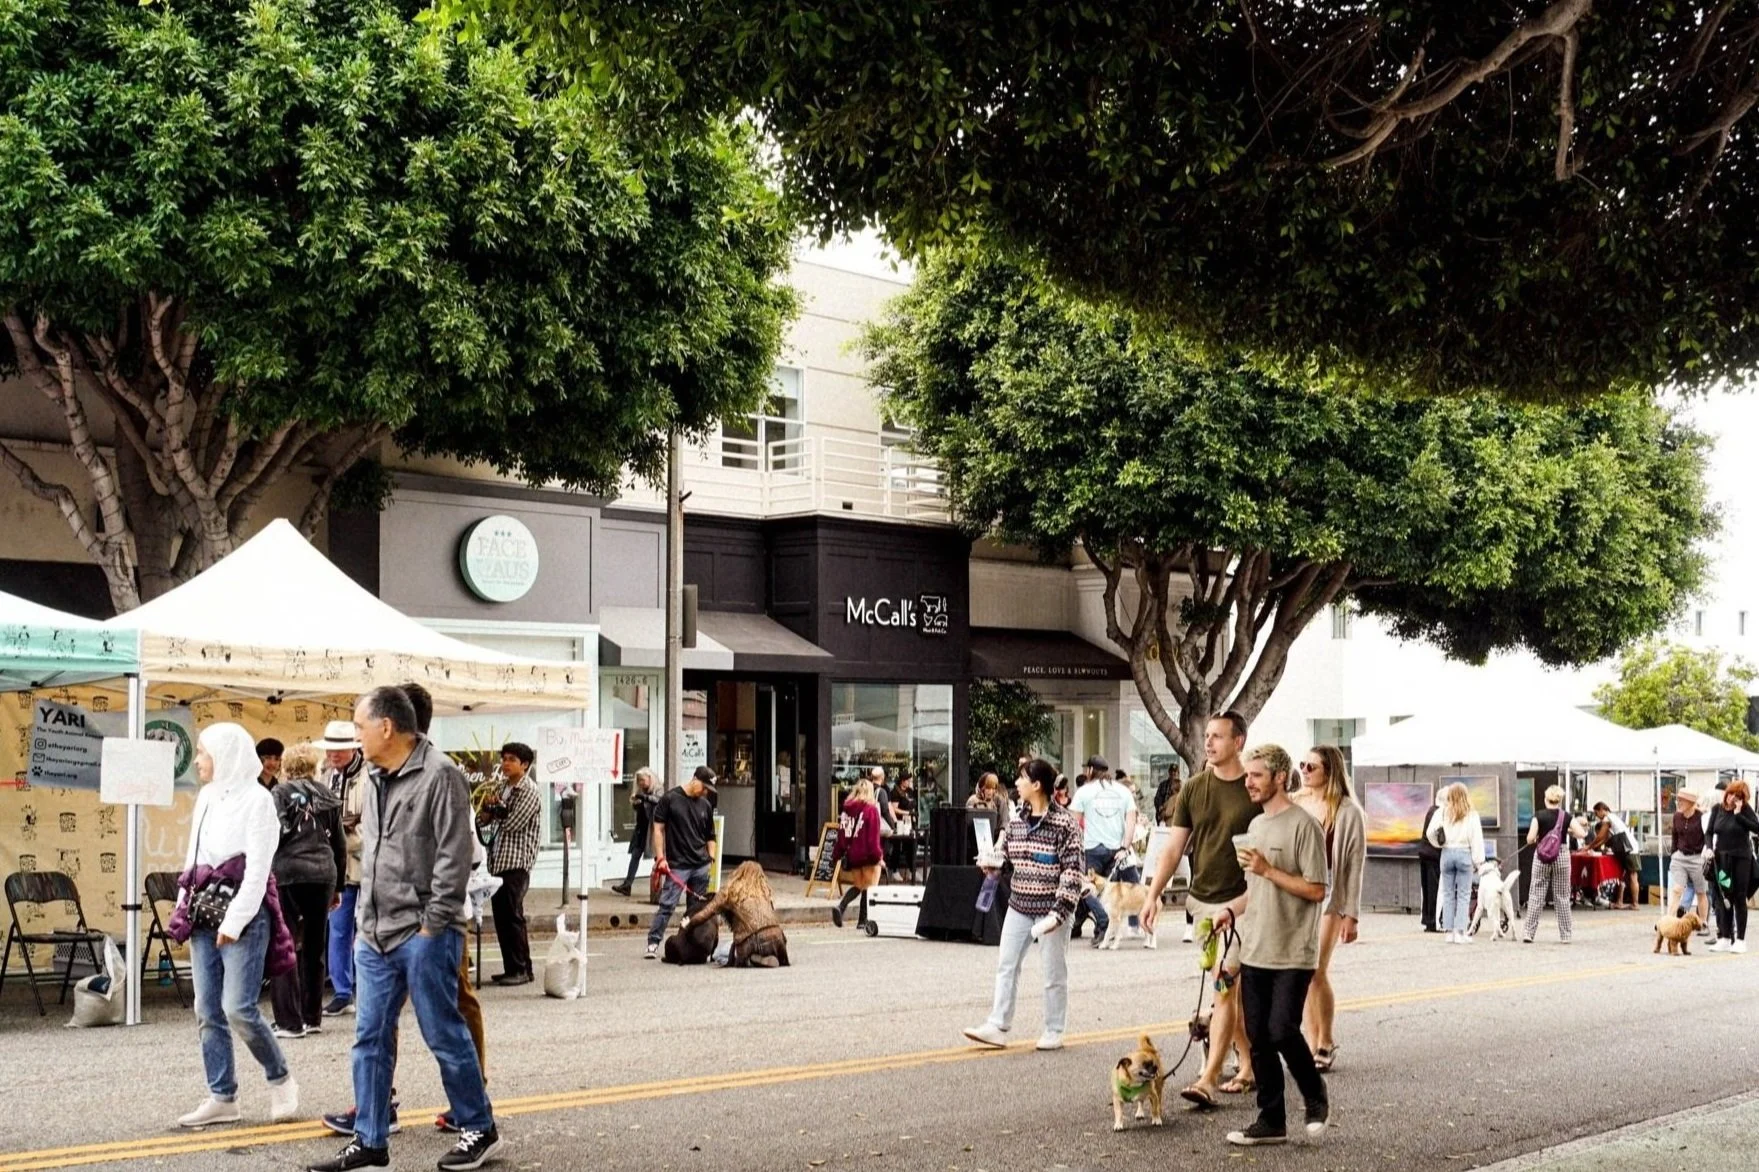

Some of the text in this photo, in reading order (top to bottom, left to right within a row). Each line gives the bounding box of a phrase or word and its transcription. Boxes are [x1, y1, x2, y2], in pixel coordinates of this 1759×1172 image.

[477, 537, 528, 558] FACE
[847, 596, 917, 627] McCall's
[1048, 666, 1065, 675] LOVE
[39, 706, 85, 728] YARI
